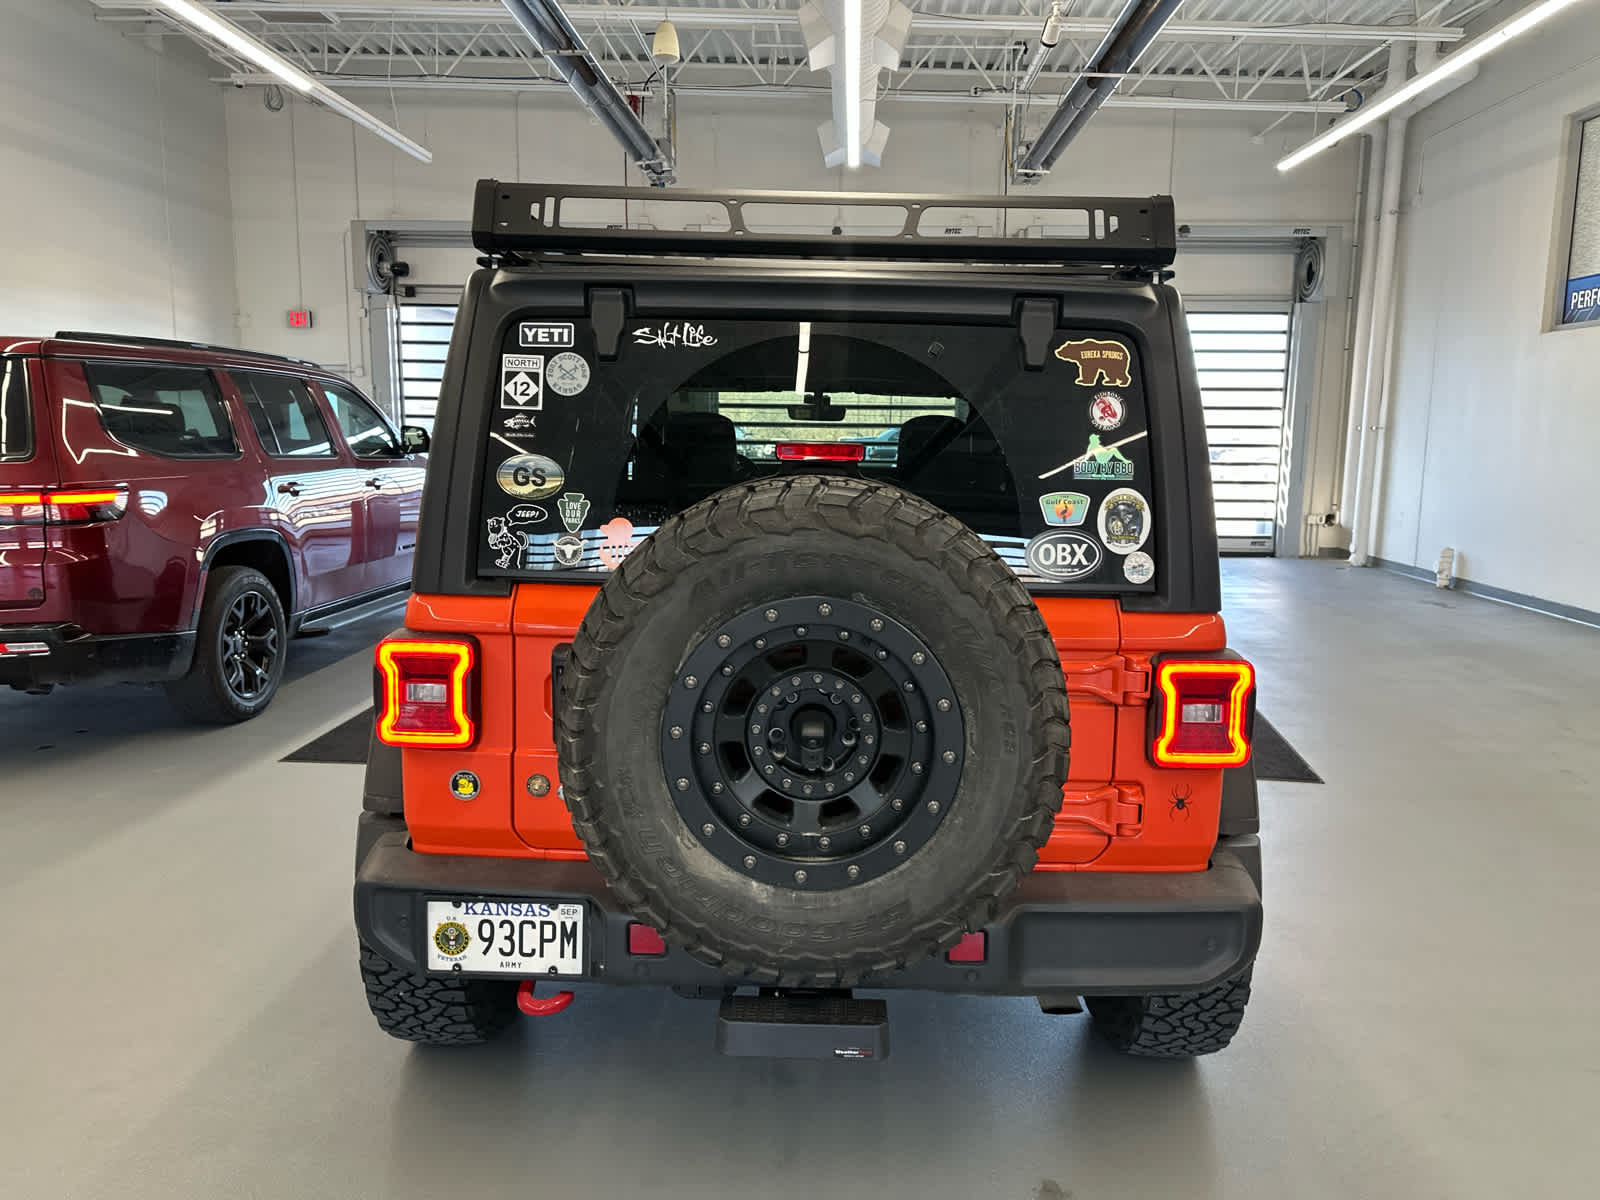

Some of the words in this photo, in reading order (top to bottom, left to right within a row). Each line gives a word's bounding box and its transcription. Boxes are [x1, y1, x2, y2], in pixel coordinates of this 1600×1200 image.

[523, 327, 569, 343] YETI
[1080, 350, 1100, 360] EUREKA
[1102, 350, 1123, 360] SPRINGS
[507, 358, 538, 368] NORTH
[512, 381, 531, 397] 12
[1074, 461, 1098, 473] BODY
[1101, 461, 1114, 473] BY
[512, 466, 547, 488] GS
[565, 502, 582, 510] LOVE
[515, 510, 540, 519] JEEP!
[565, 510, 582, 518] OUR
[1039, 543, 1089, 566] OBX
[463, 902, 551, 917] KANSAS
[560, 908, 578, 916] SEP
[477, 918, 577, 960] 93CPM
[499, 961, 523, 969] ARMY
